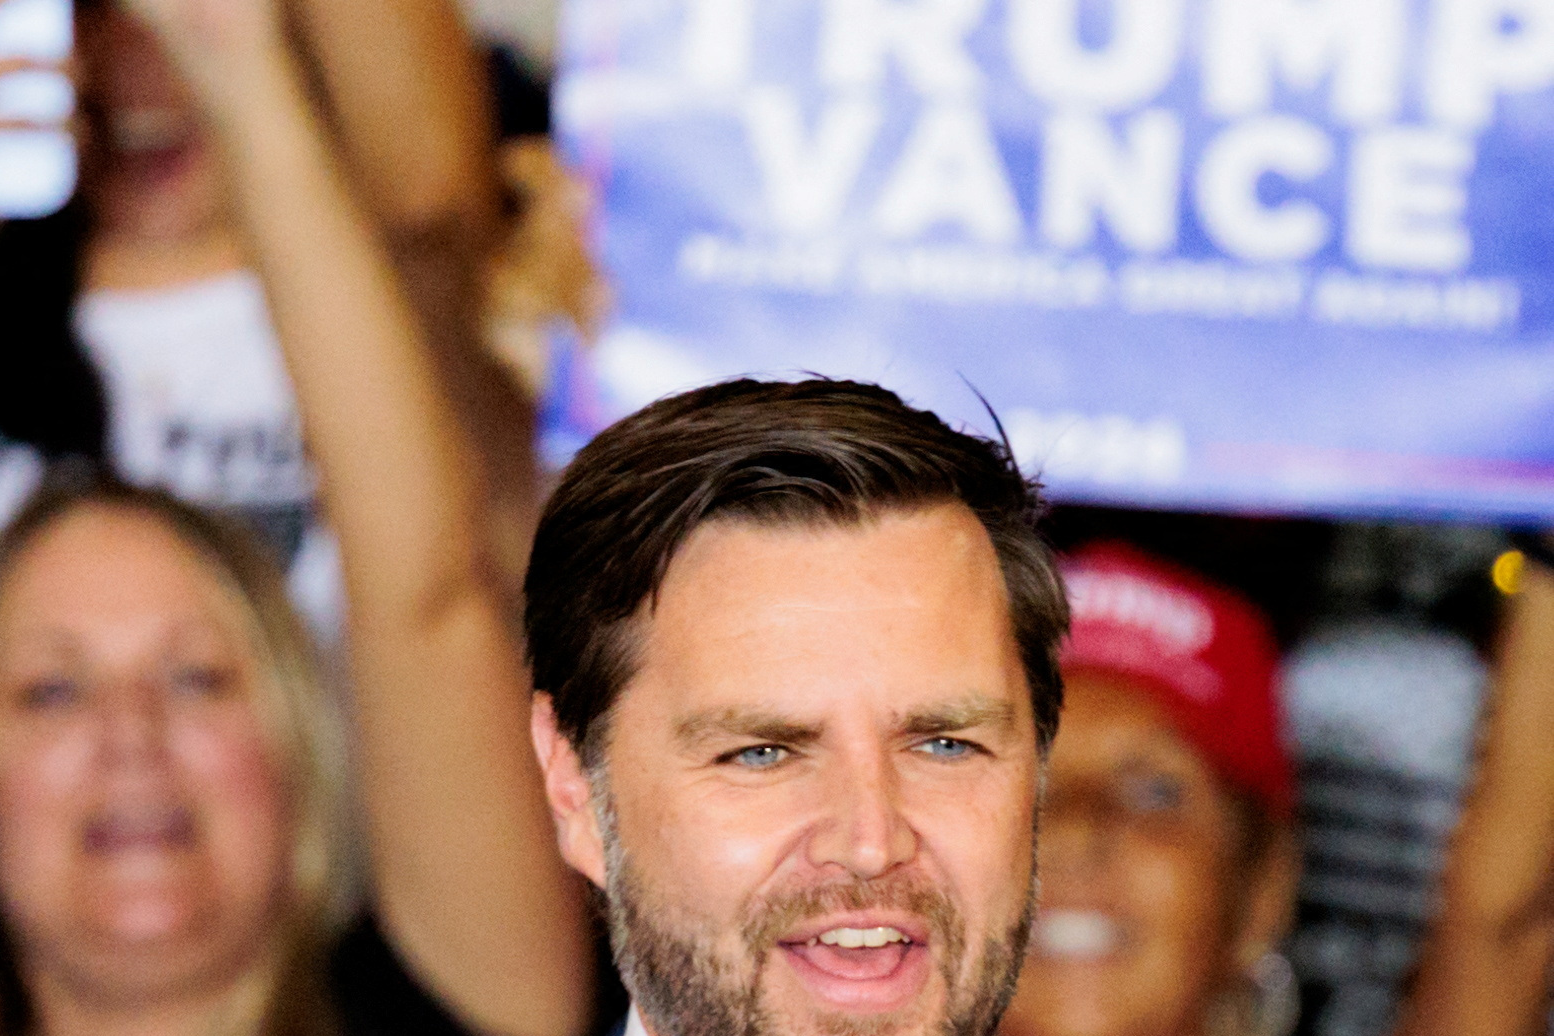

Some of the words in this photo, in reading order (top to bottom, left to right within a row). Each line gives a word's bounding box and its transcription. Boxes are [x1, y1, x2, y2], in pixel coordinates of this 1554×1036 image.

[741, 84, 1478, 274] VANCE
[858, 242, 1108, 310] AMERICA
[1120, 257, 1304, 322] GREAT
